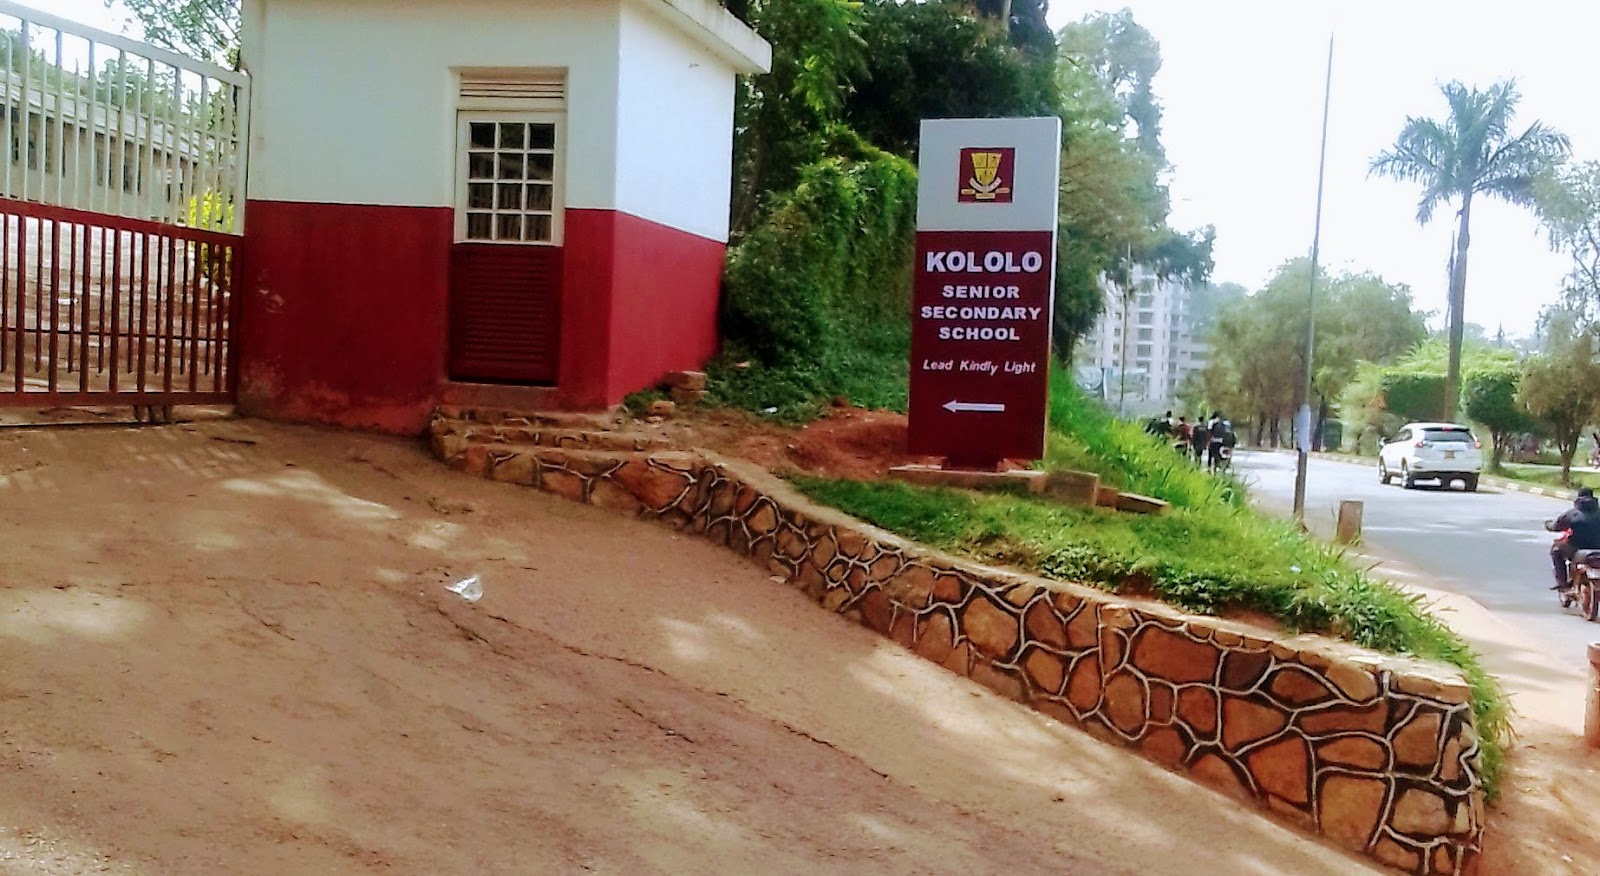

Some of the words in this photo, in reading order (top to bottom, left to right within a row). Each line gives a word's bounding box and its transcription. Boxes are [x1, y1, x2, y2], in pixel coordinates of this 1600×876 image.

[926, 251, 1043, 273] KOLOLO
[941, 285, 1020, 299] SENIOR
[920, 306, 1042, 320] SECONDARY
[938, 327, 1020, 341] SCHOOL
[923, 359, 954, 371] Lead
[959, 360, 999, 376] Kindly
[1004, 361, 1036, 374] Light
